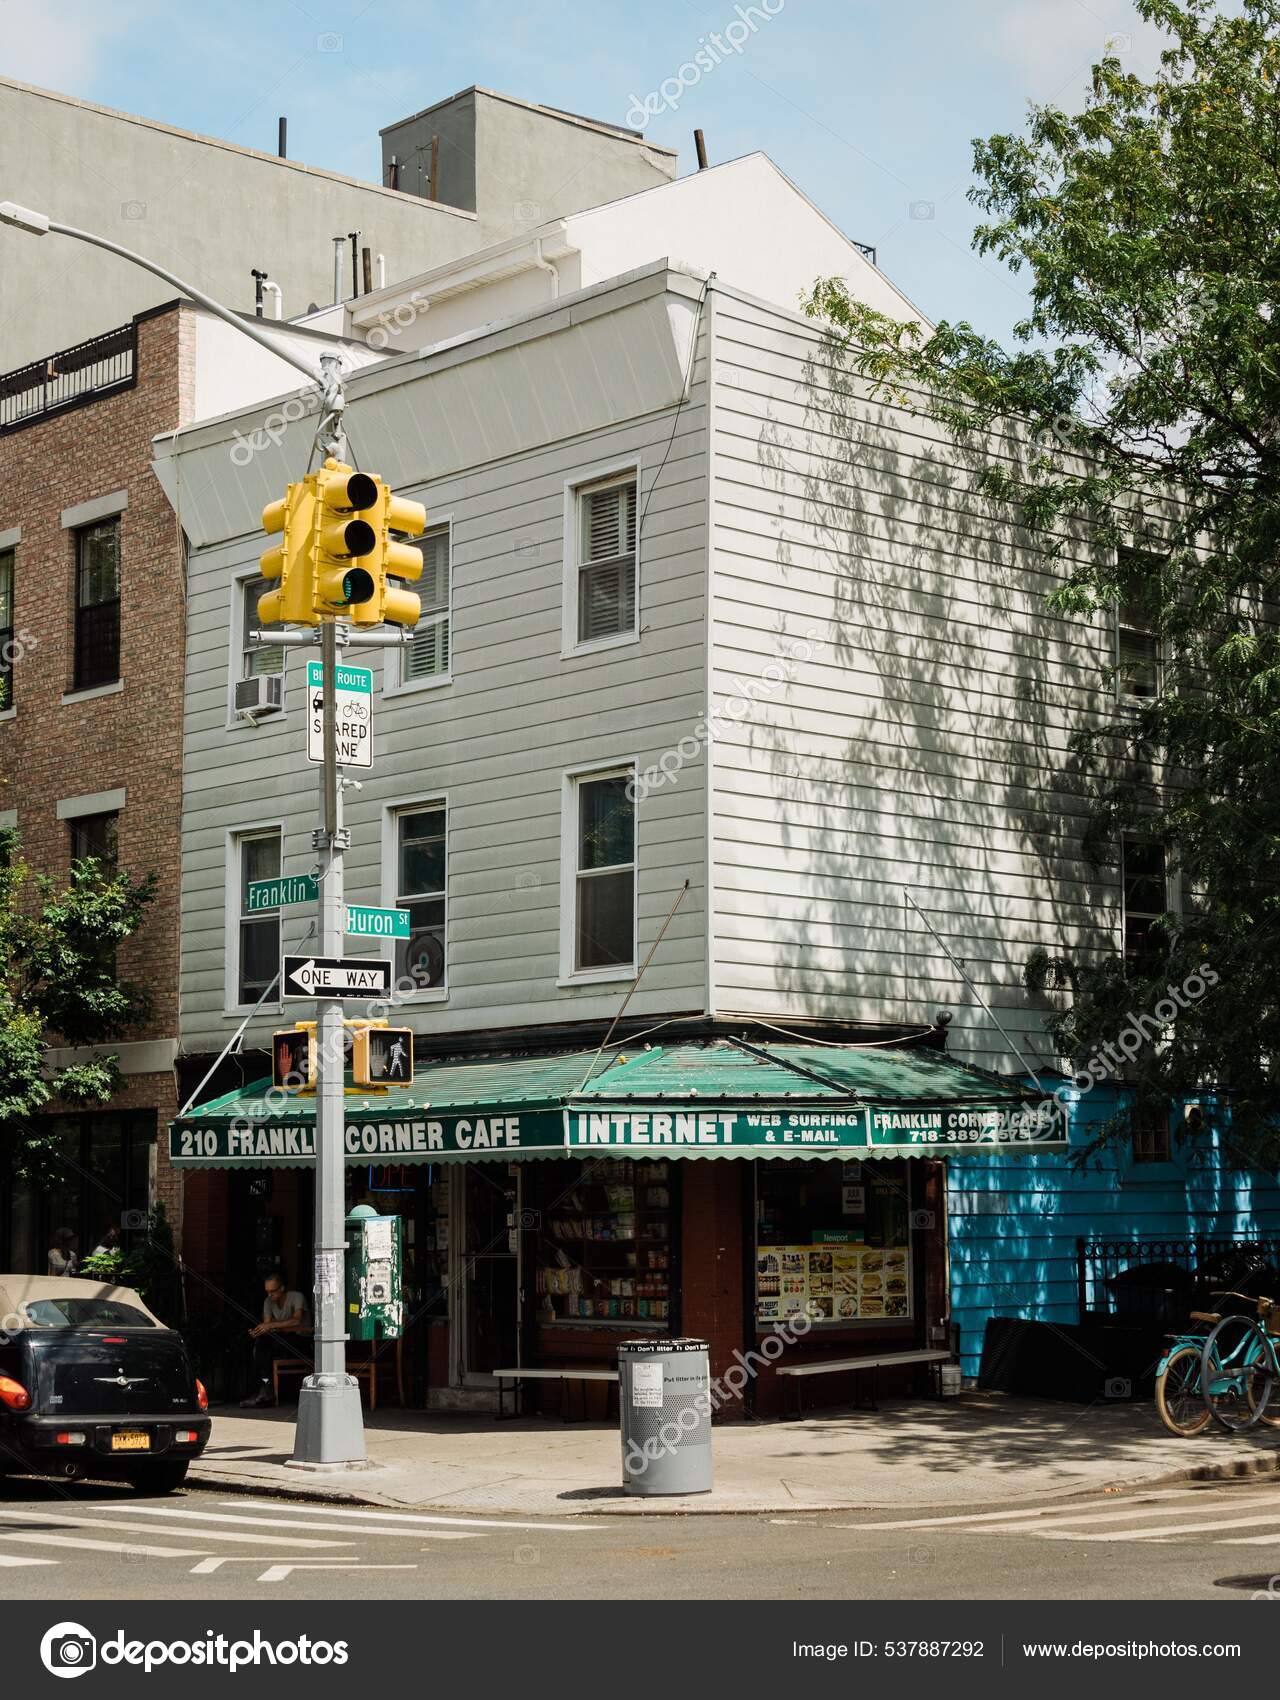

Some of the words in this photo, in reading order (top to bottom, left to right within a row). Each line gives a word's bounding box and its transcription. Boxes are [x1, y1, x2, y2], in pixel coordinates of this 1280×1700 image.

[337, 672, 367, 687] ROUTE
[314, 719, 367, 739] SARED
[335, 742, 358, 758] ANE
[249, 878, 306, 909] Franklin
[347, 909, 393, 934] Huron
[399, 913, 408, 925] St
[301, 969, 331, 985] ONE
[346, 971, 378, 987] WAY
[578, 1113, 738, 1144] INTERNET
[747, 1114, 782, 1127] WEB
[788, 1114, 858, 1127] SURFING
[874, 1113, 942, 1129] FRANKLIN
[948, 1112, 1004, 1127] CORNER
[180, 1129, 218, 1156] 210
[227, 1127, 317, 1155] FRANKLI
[345, 1121, 444, 1153] CORNER
[455, 1117, 520, 1149] CAFE
[765, 1130, 776, 1142] &
[783, 1130, 839, 1142] E-MAIL
[823, 1233, 849, 1242] Newport
